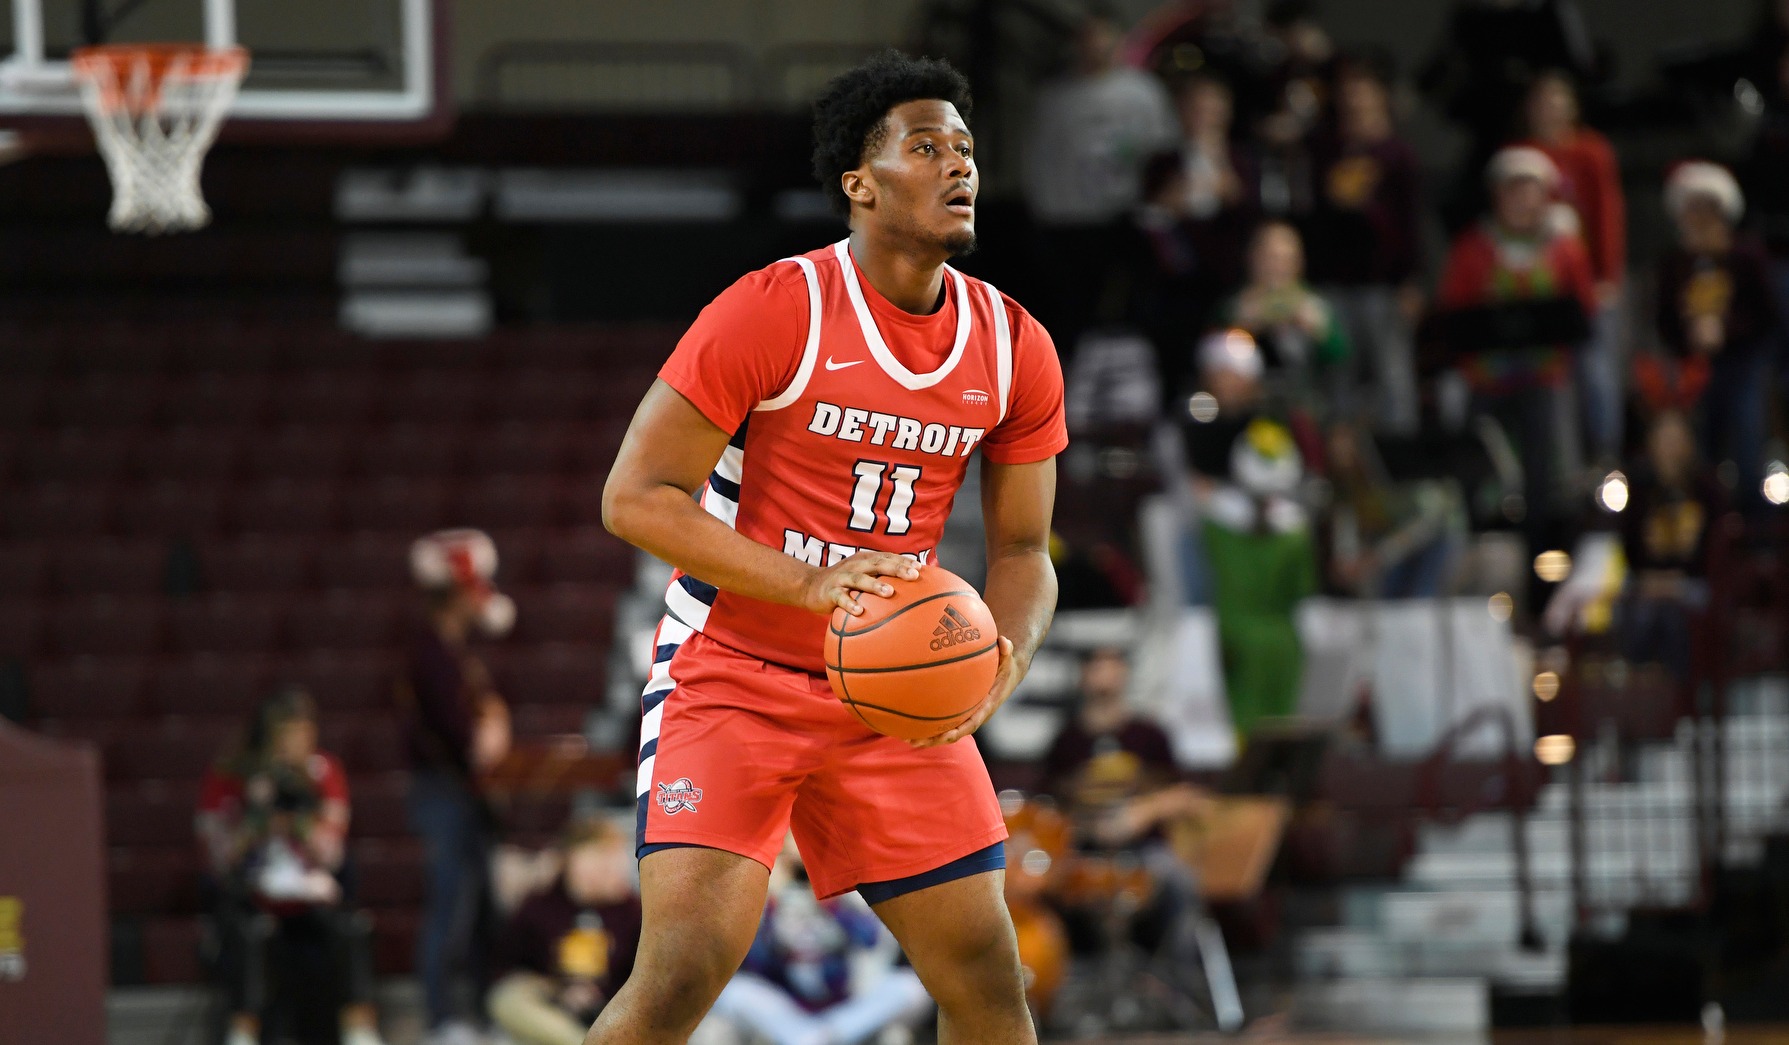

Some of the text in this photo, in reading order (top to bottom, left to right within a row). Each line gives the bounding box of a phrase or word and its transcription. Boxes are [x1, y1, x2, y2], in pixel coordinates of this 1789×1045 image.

[962, 393, 989, 402] HORIZON
[807, 401, 986, 457] DETROIT
[847, 458, 923, 536] 11
[929, 627, 981, 652] adidas
[657, 789, 702, 804] TITANS
